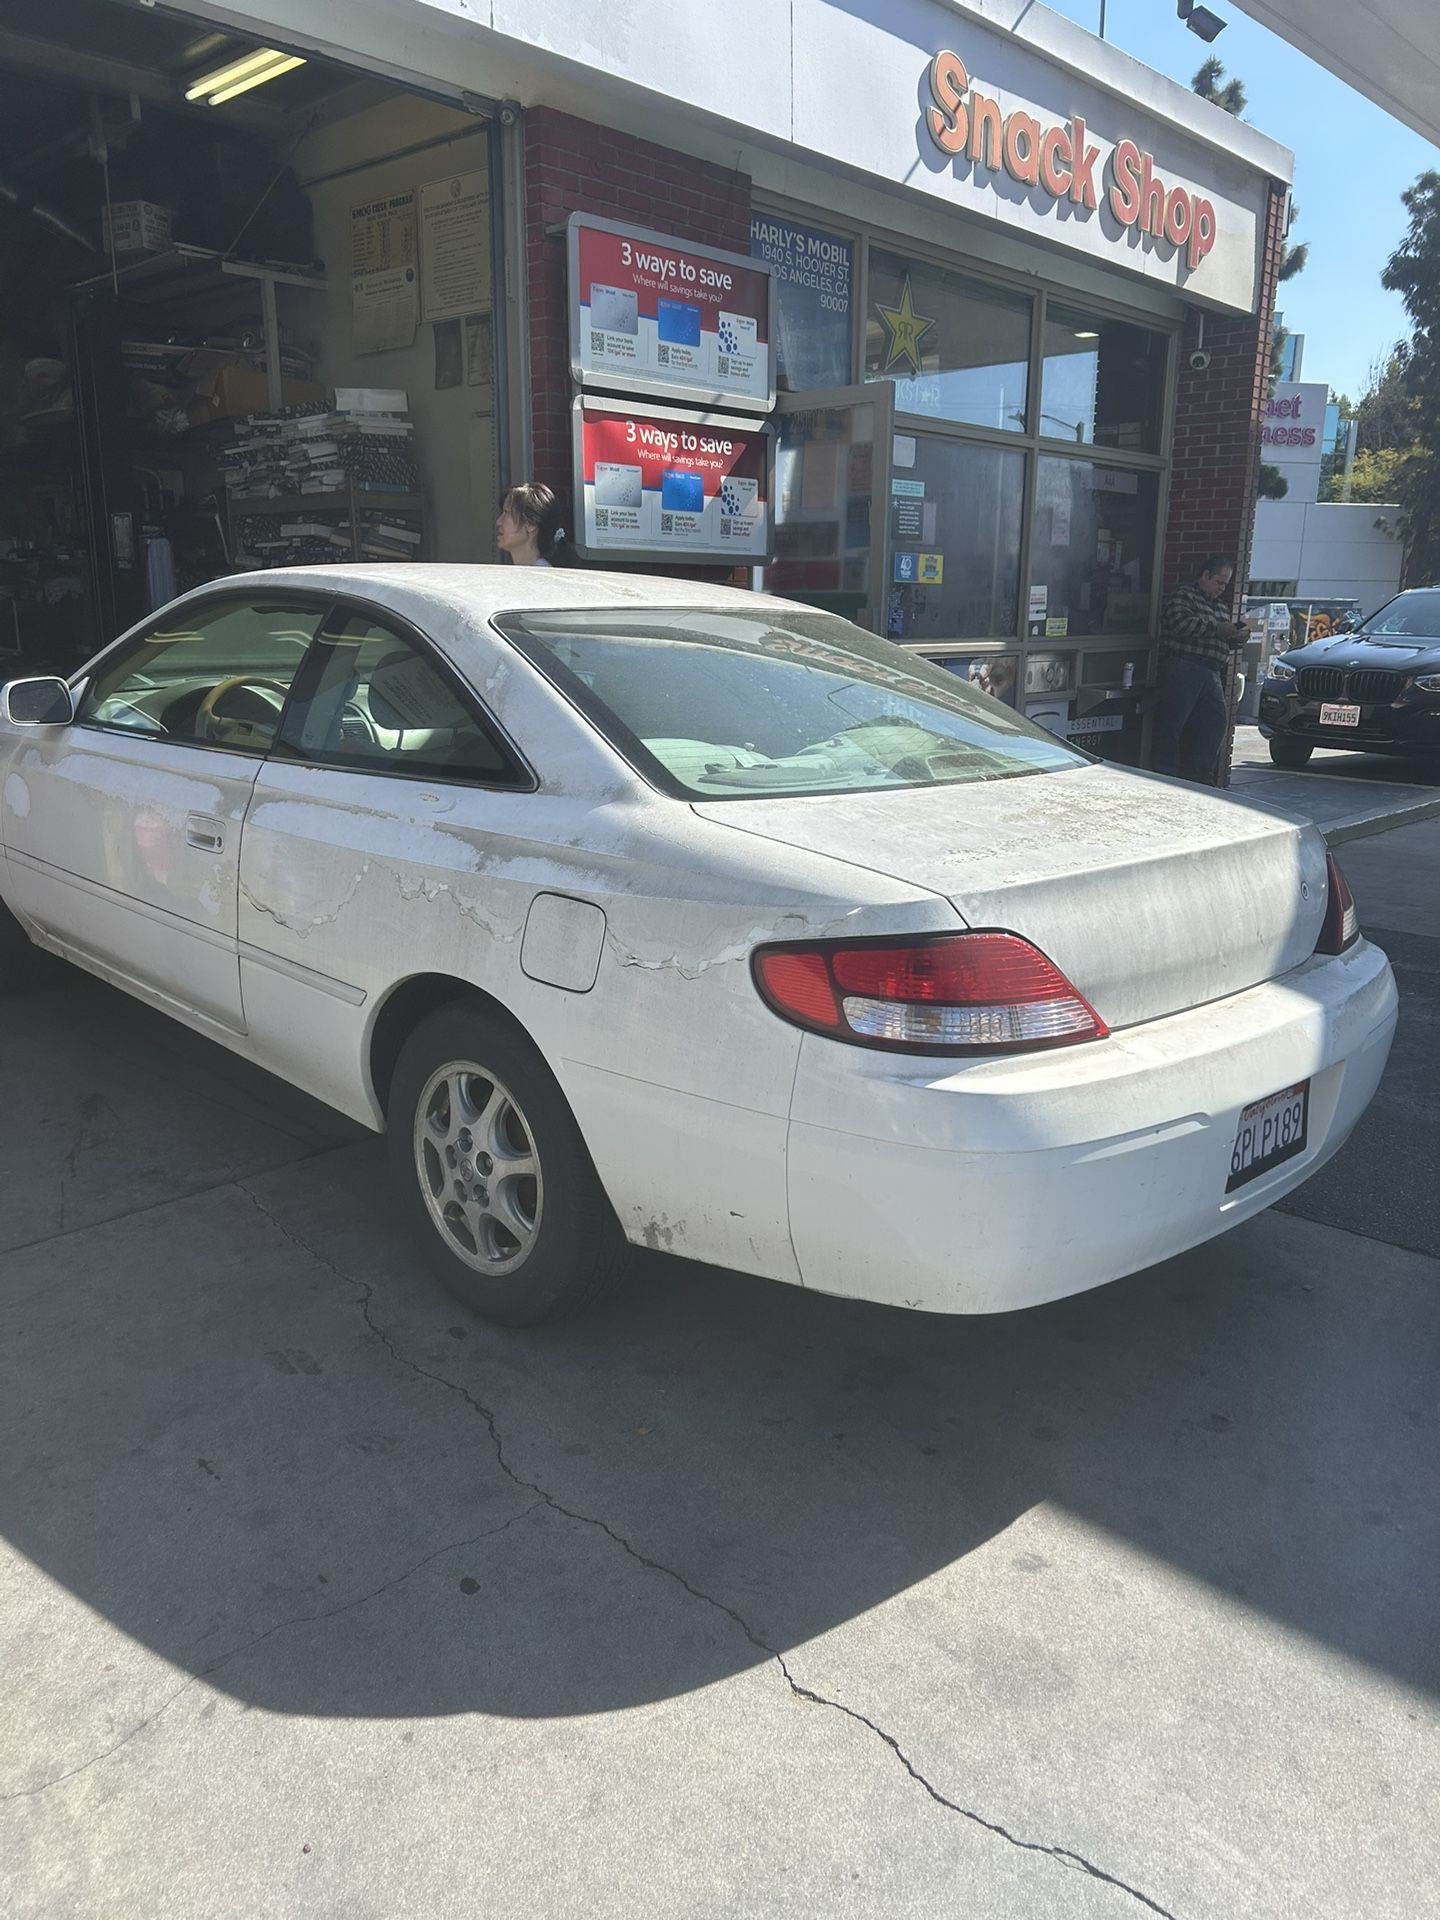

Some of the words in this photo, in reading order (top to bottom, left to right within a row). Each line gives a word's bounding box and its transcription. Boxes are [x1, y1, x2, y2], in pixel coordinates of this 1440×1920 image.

[926, 49, 1100, 211] Snack
[1111, 139, 1217, 271] Shop
[352, 205, 371, 220] SMOG
[621, 242, 632, 266] 3
[636, 252, 676, 281] ways
[679, 259, 697, 282] to
[700, 268, 733, 290] save
[761, 243, 784, 262] 1940
[785, 251, 794, 266] S.
[796, 255, 836, 278] HOOVER
[838, 266, 849, 281] ST.
[808, 237, 849, 266] MOBIL
[632, 273, 656, 288] Where
[657, 280, 668, 291] will
[669, 284, 694, 299] savings
[694, 289, 708, 299] take
[708, 292, 723, 303] you?
[789, 270, 834, 294] ANGELES,
[835, 282, 849, 296] CA
[820, 294, 849, 313] 90007
[626, 421, 636, 442] 3
[640, 428, 678, 452] ways
[681, 432, 698, 451] to
[700, 438, 733, 456] save
[637, 448, 660, 460] Where
[661, 452, 672, 462] will
[672, 456, 694, 468] savings
[695, 458, 710, 467] take
[710, 460, 724, 470] you?
[1072, 716, 1114, 730] ESSENTIAL
[1231, 1102, 1303, 1174] 6PLP189
